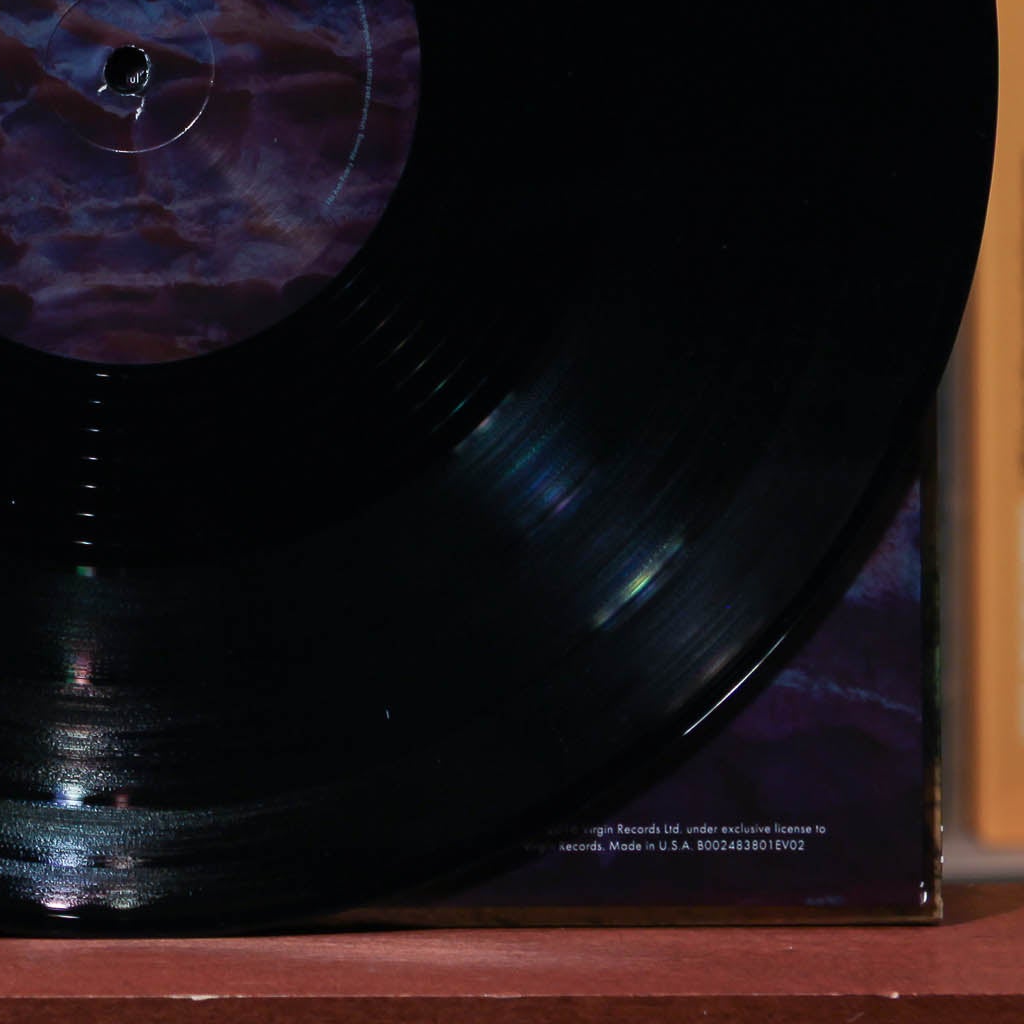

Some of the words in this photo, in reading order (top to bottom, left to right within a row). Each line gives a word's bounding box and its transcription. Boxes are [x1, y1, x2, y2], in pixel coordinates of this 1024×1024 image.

[618, 824, 660, 834] Records
[687, 823, 718, 834] under
[722, 823, 770, 834] exclusive
[775, 824, 812, 834] license
[816, 825, 826, 834] to
[609, 840, 642, 851] Made
[646, 842, 655, 850] in
[698, 840, 804, 851] B002483801EV02
